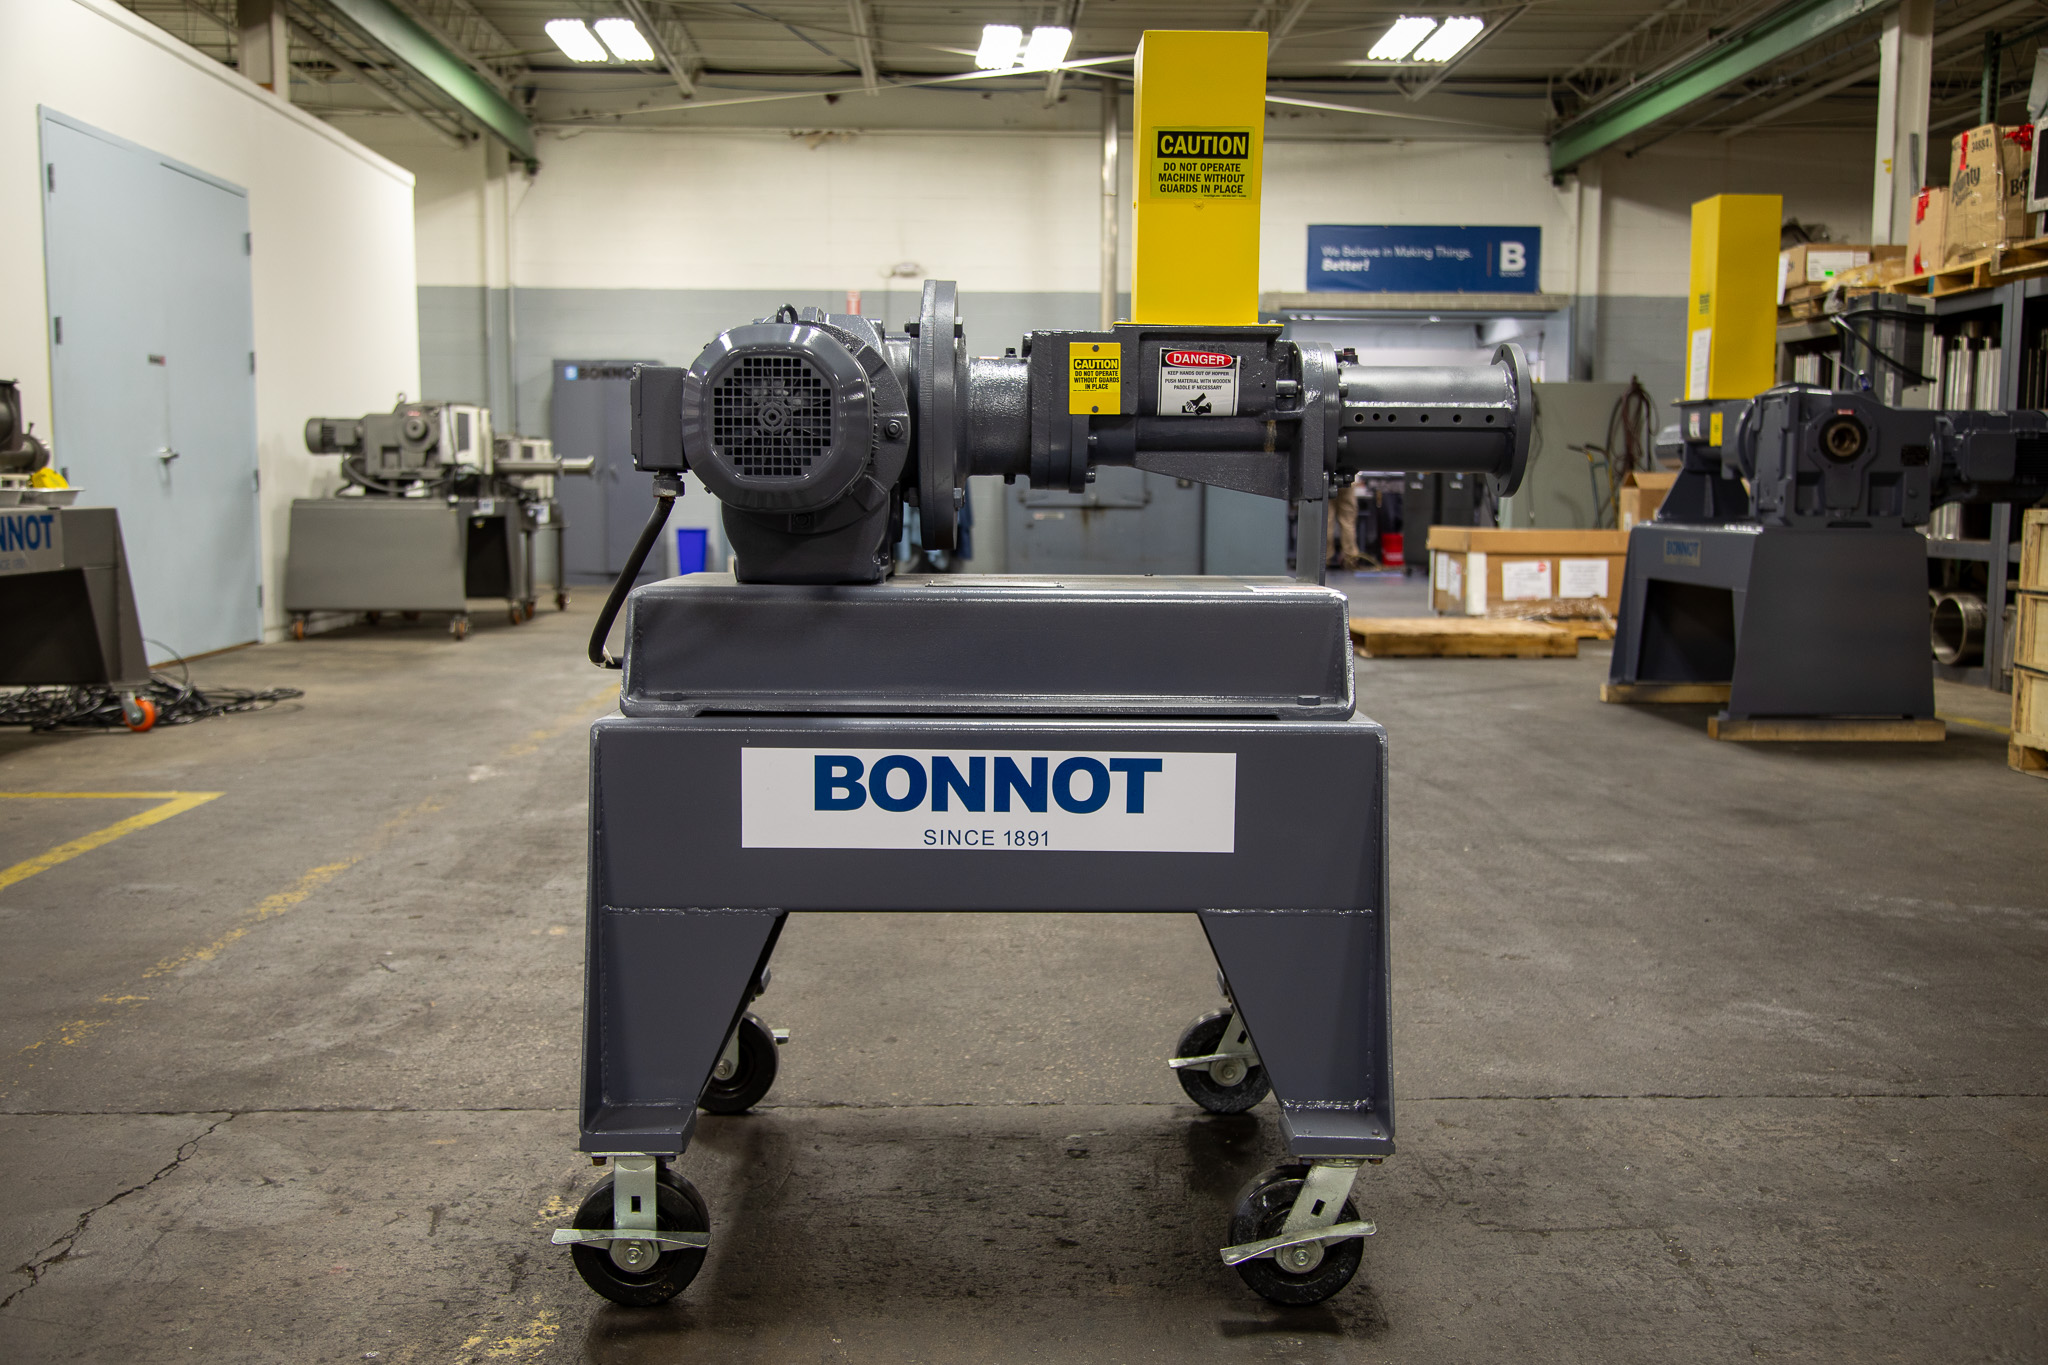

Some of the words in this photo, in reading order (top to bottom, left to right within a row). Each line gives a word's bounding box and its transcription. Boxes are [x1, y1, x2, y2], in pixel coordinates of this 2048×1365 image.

[1160, 135, 1246, 155] CAUTION
[1163, 162, 1176, 172] DO
[1179, 162, 1198, 172] NOT
[1200, 162, 1241, 172] OPERATE
[1158, 173, 1201, 182] MACHINE
[1203, 173, 1245, 183] WITHOUT
[1160, 184, 1198, 193] GUARDS
[1201, 184, 1211, 193] IN
[1213, 184, 1243, 194] PLACE
[1320, 246, 1341, 258] We
[1342, 246, 1381, 258] Believe
[1382, 246, 1393, 258] in
[1394, 246, 1434, 261] Making
[1500, 241, 1526, 272] B
[1321, 258, 1371, 272] Better!
[1074, 359, 1118, 369] CAUTION
[1172, 353, 1225, 366] DANGER
[578, 367, 635, 380] BONNO
[814, 754, 1163, 814] BONNOT
[923, 829, 995, 846] SINCE
[1003, 830, 1050, 847] 1891
